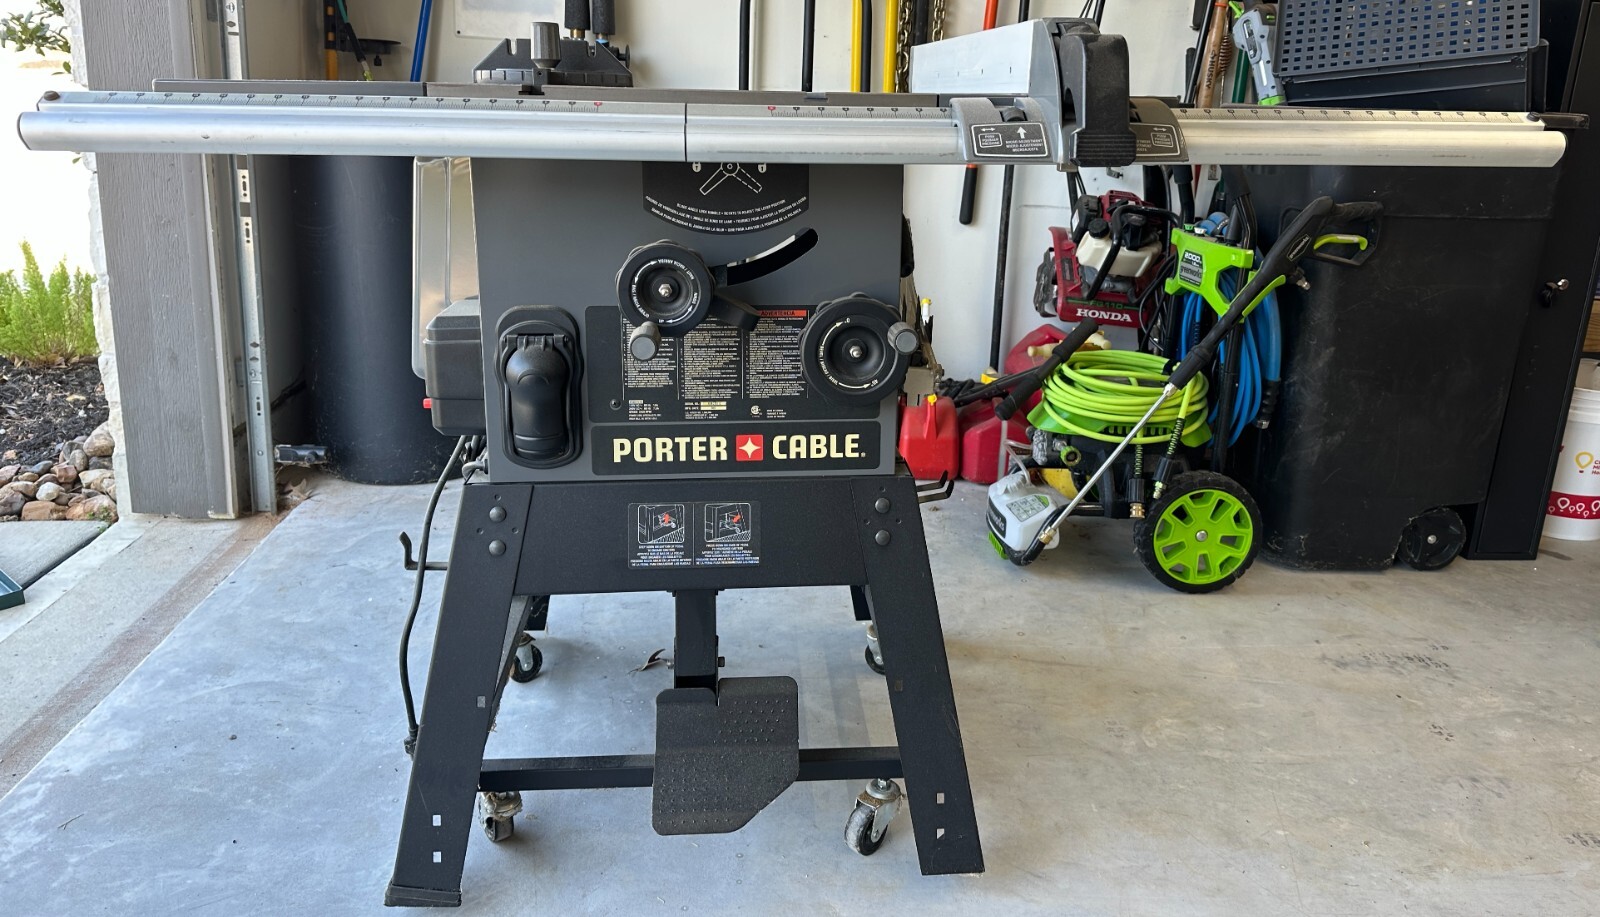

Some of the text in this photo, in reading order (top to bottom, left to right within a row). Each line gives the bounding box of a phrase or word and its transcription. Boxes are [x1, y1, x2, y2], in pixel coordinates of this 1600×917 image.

[1205, 60, 1216, 89] HUSKY
[1075, 308, 1133, 322] HONDA
[613, 436, 728, 463] PORTER
